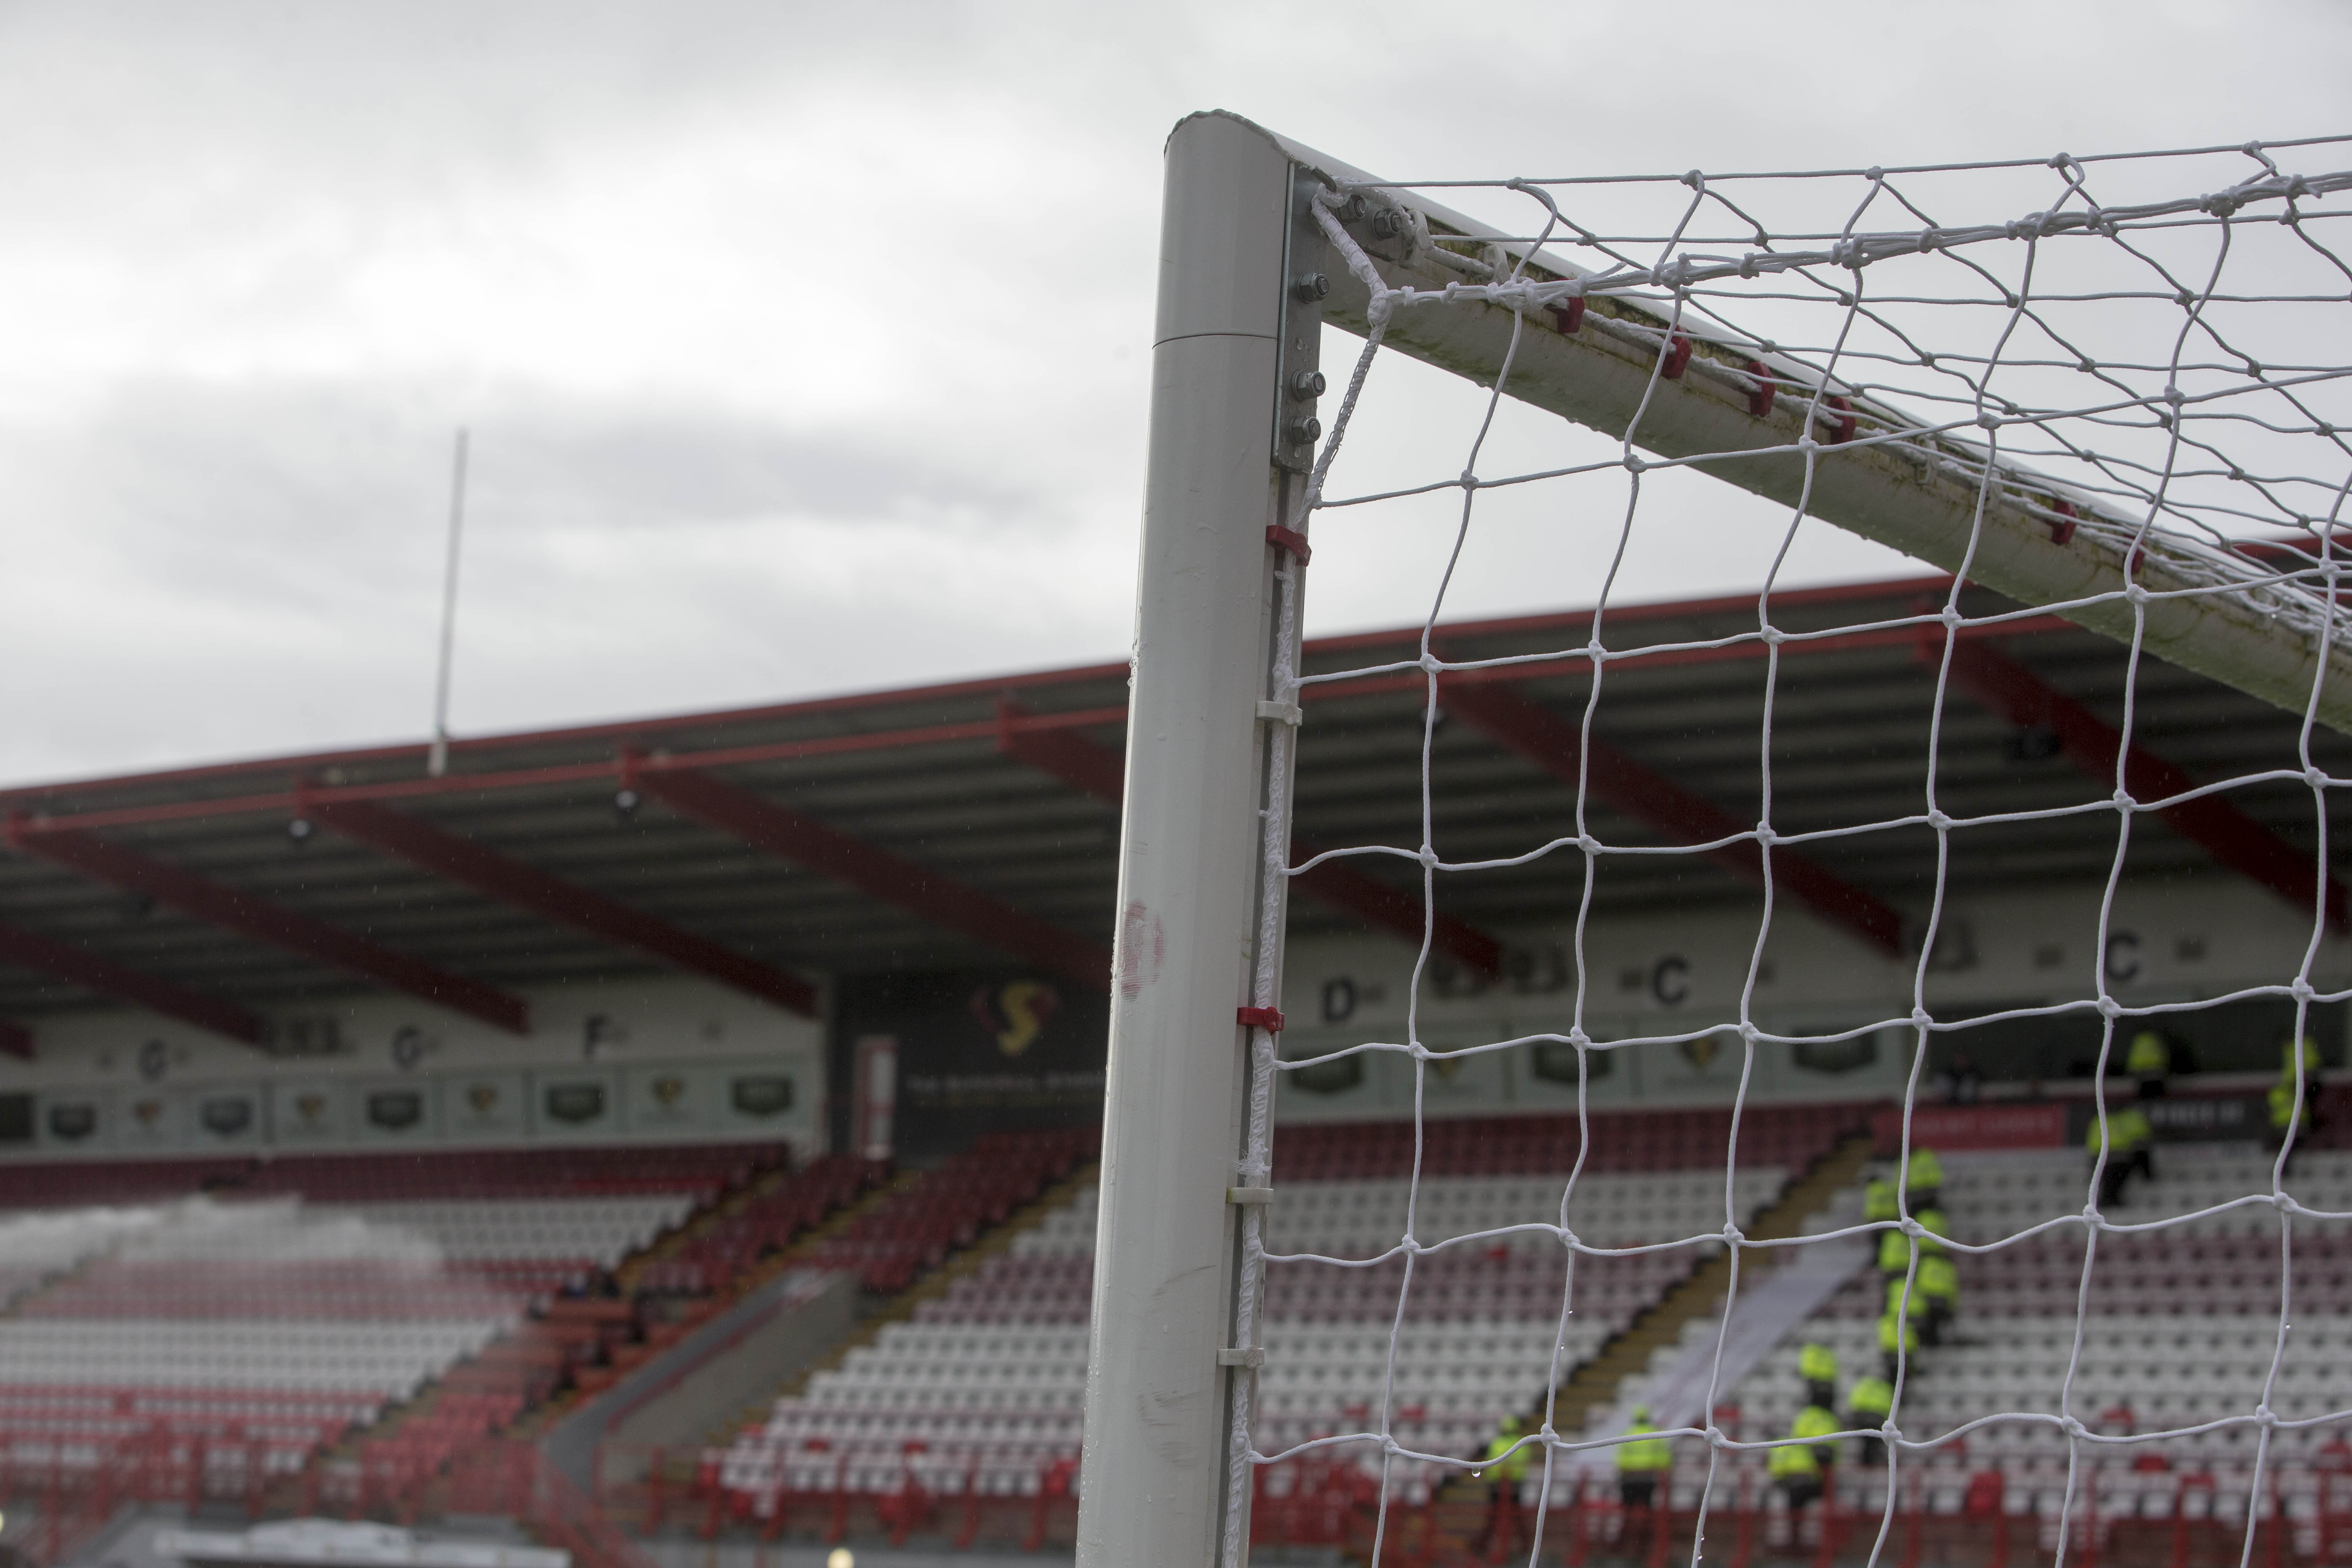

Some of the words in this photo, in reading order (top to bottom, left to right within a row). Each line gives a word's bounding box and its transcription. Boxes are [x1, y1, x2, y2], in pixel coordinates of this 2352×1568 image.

[2103, 930, 2140, 980] C
[1323, 978, 1356, 1022] D
[1654, 956, 1689, 1004] C
